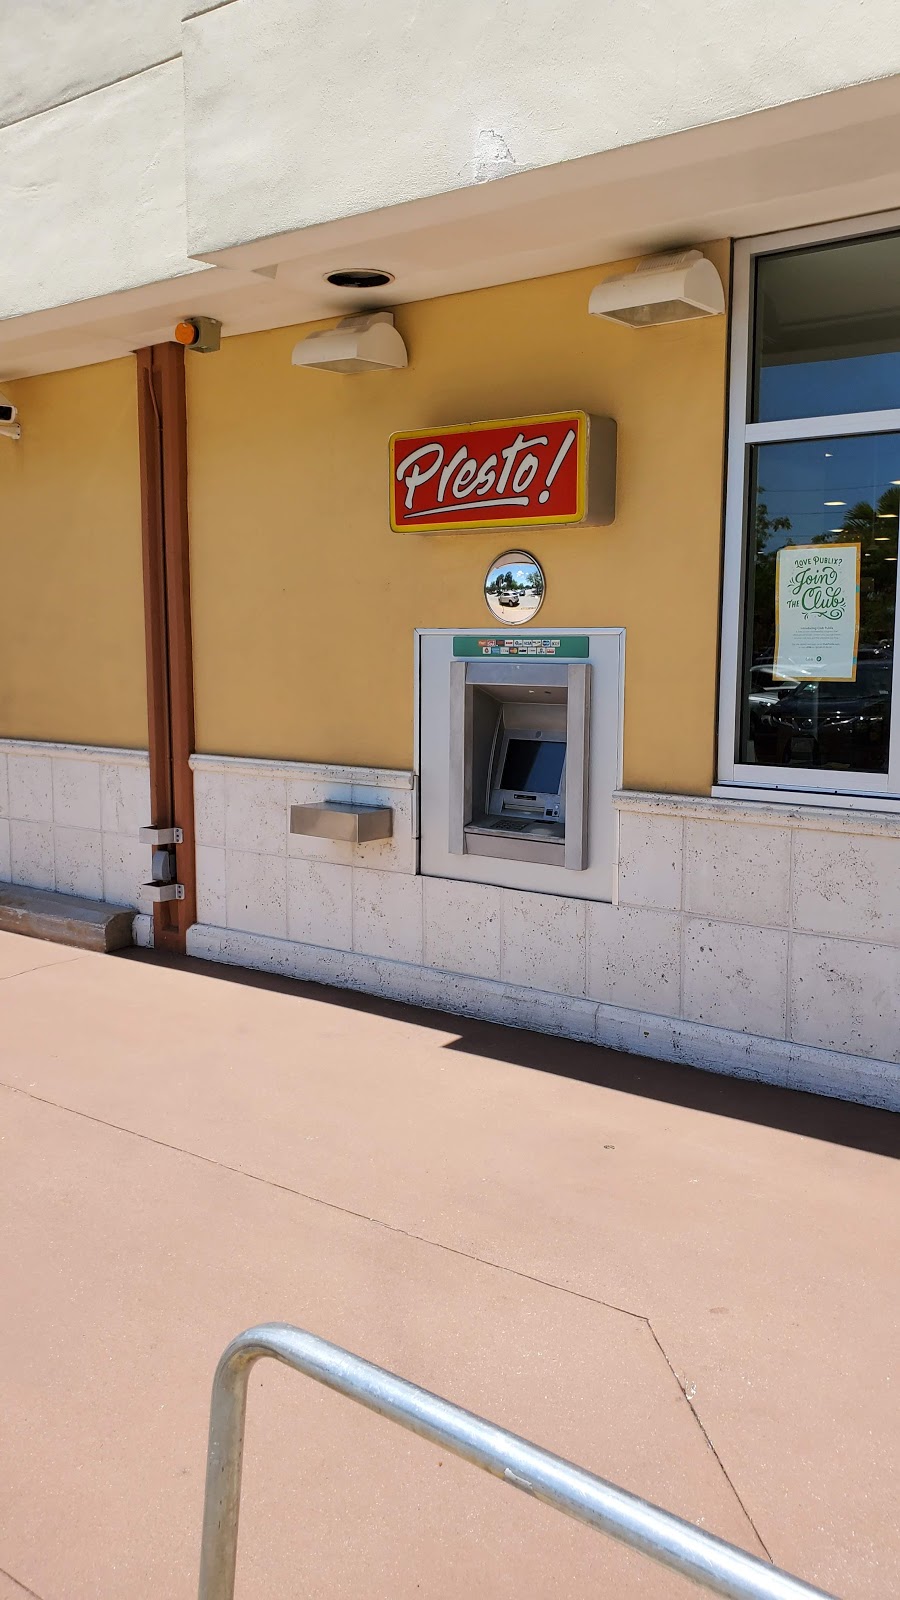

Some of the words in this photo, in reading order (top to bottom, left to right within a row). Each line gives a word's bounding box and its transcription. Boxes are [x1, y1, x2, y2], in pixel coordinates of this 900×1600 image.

[396, 429, 576, 511] Presto!
[794, 558, 812, 569] LOVE
[813, 555, 843, 567] PUBLIX?
[792, 566, 838, 596] Join
[786, 599, 800, 609] THE
[801, 586, 845, 611] Club
